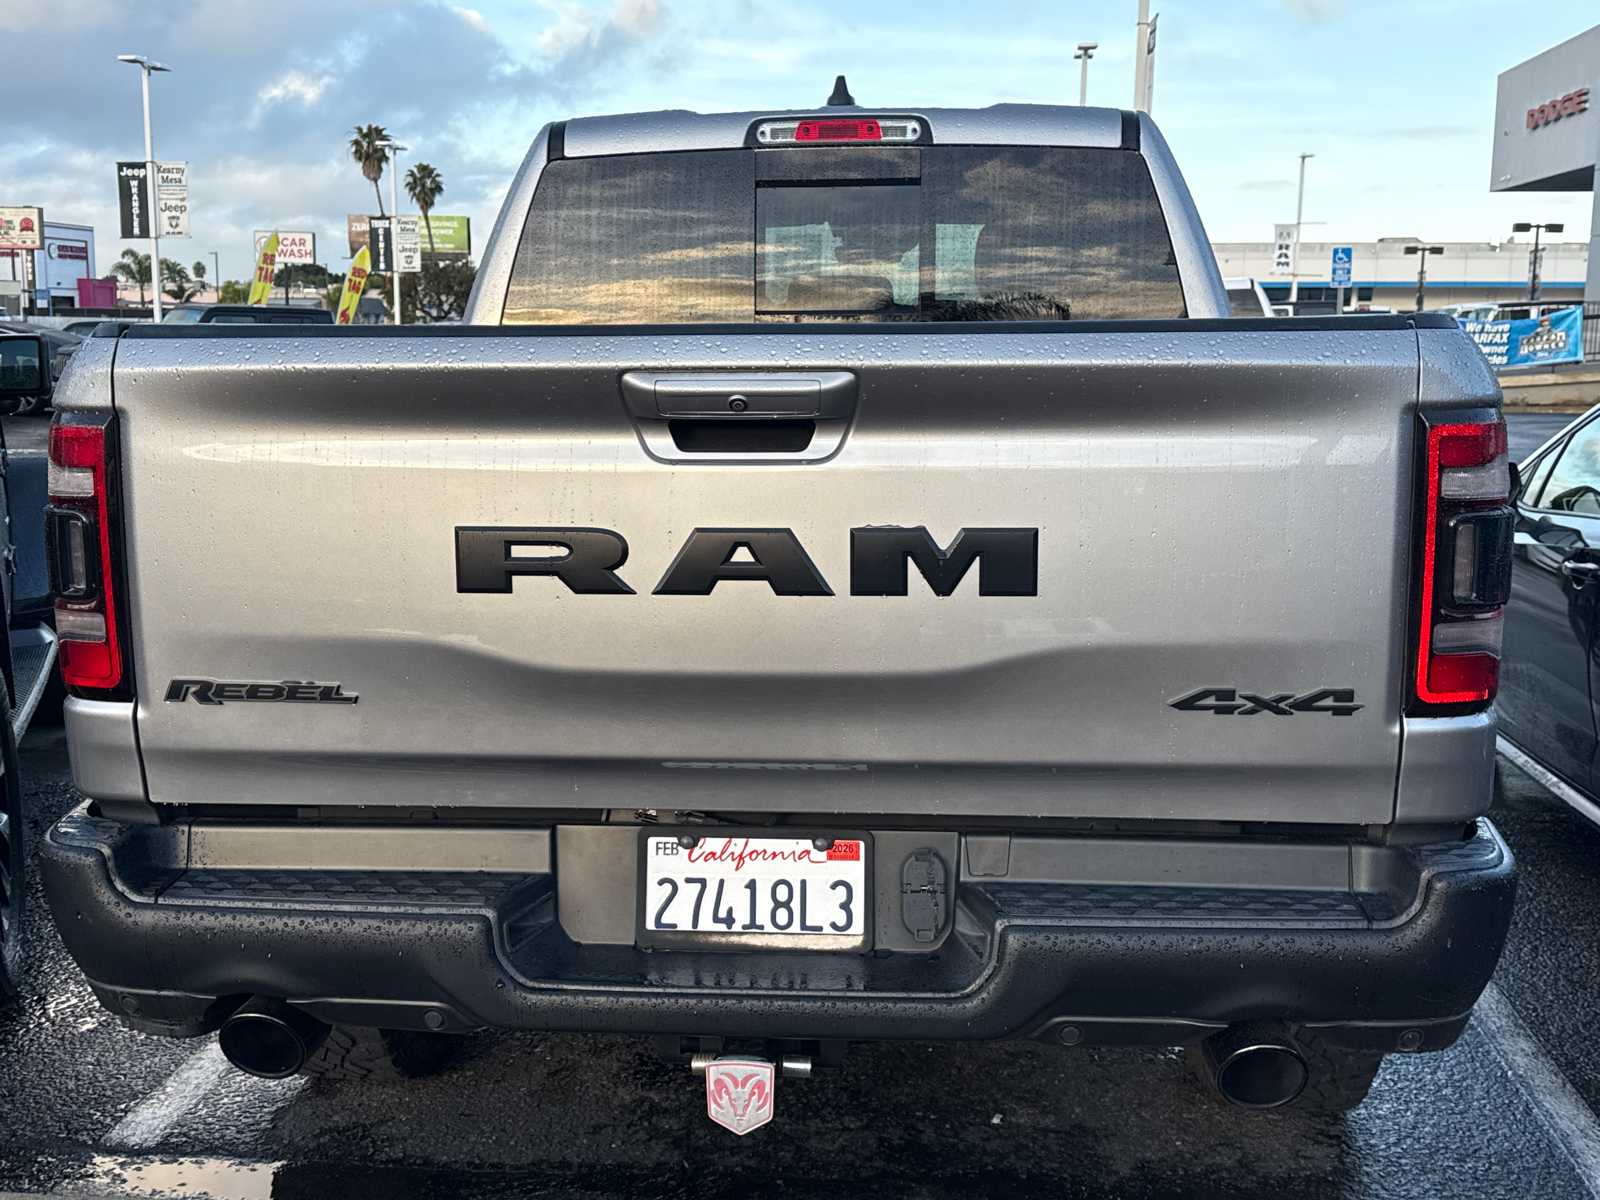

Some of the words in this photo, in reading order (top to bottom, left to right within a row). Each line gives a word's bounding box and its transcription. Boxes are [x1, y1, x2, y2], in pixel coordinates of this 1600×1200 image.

[1526, 87, 1590, 129] DODGE
[120, 166, 146, 178] Jeep
[157, 165, 185, 177] Kearny
[161, 175, 182, 184] Mesa
[129, 180, 140, 236] WRANGLER
[160, 202, 187, 214] Jeep
[281, 237, 307, 247] CAR
[276, 249, 312, 258] WASH
[399, 246, 419, 254] Jeep
[262, 252, 276, 266] RE
[257, 266, 275, 285] TAG
[351, 266, 367, 280] RED
[347, 278, 362, 295] TAG
[1465, 322, 1482, 333] We
[1484, 322, 1511, 333] have
[454, 525, 1039, 597] RAM
[164, 677, 359, 705] REBEL
[655, 841, 679, 856] FEB
[687, 837, 827, 872] California
[832, 843, 854, 853] 2026
[654, 877, 854, 933] 27418L3
